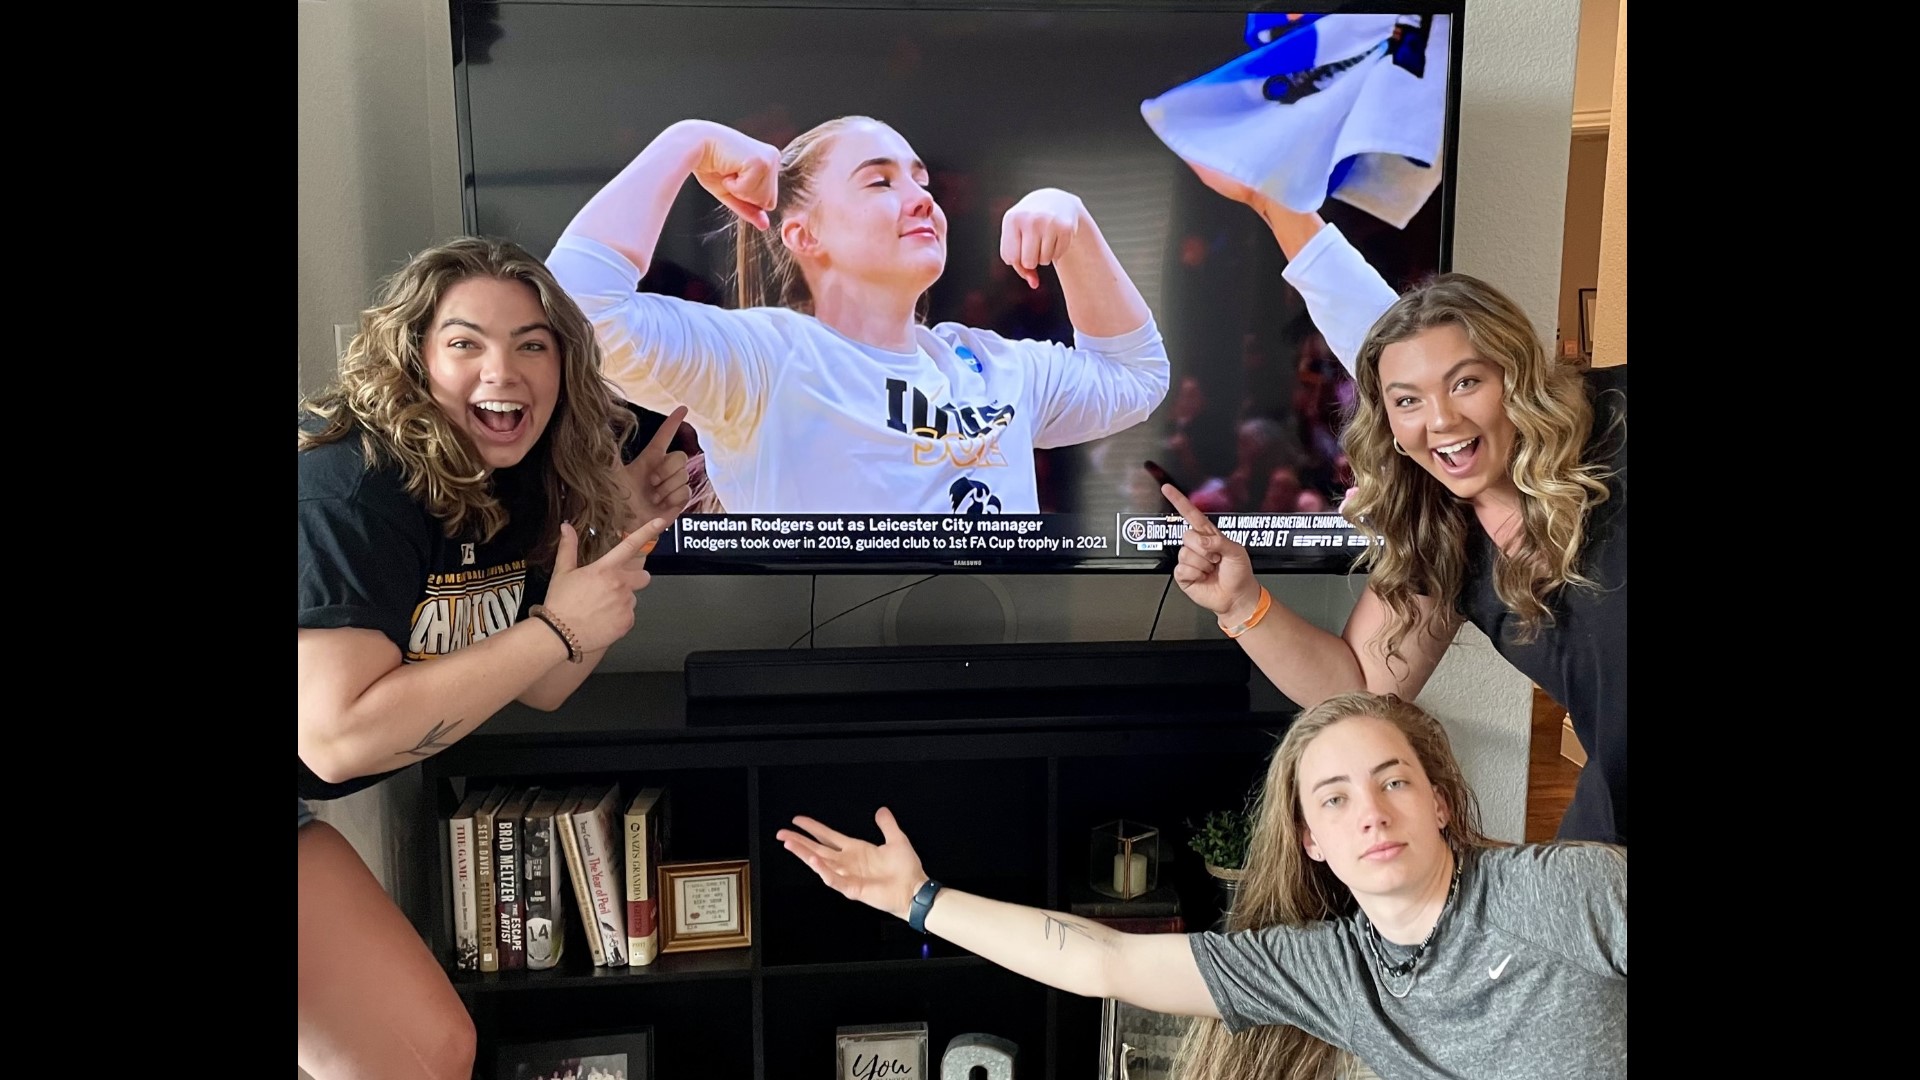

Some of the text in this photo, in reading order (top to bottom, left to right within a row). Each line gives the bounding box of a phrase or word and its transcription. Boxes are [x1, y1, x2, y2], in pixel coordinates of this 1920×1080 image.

[682, 518, 1043, 534] Brendan Rodgers out as Leicester City manager
[1270, 515, 1312, 529] BASKETBALL
[684, 536, 1108, 551] Rodgers took over in 2019, guided club to 1st FA Cup trophy in 2021
[1249, 530, 1275, 547] 3:30
[1275, 530, 1290, 547] ET
[457, 825, 466, 849] THE
[478, 824, 489, 876] SETH DAVIS
[498, 822, 515, 902] BRAD MELTZER
[458, 849, 468, 882] GAME
[589, 857, 611, 915] The Year of Peril
[481, 882, 491, 919] GETTING
[511, 904, 519, 916] THE
[482, 922, 491, 933] TO
[501, 912, 511, 944] ARTIST
[511, 917, 522, 951] ESCAPE
[528, 923, 549, 942] 14
